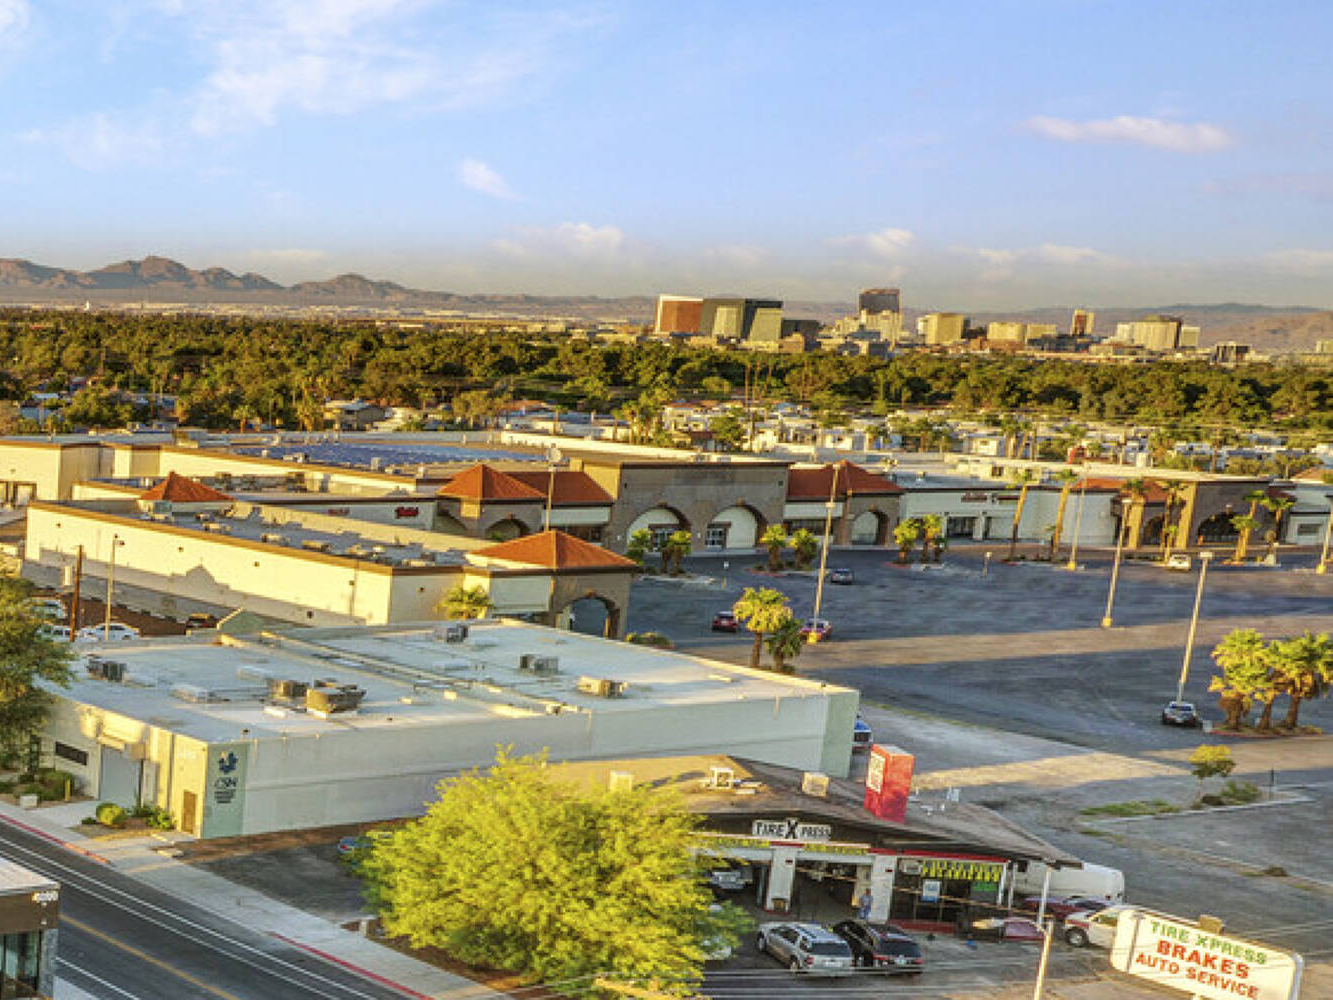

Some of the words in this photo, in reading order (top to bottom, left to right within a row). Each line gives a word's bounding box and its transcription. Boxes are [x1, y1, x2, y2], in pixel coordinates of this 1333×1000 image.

[755, 821, 785, 837] TIRE
[1150, 921, 1189, 943] TIRE
[1194, 933, 1266, 965] XPRESS
[1156, 940, 1250, 979] BRAKES
[1136, 953, 1180, 974] AUTO
[1185, 966, 1259, 1000] SERVICE
